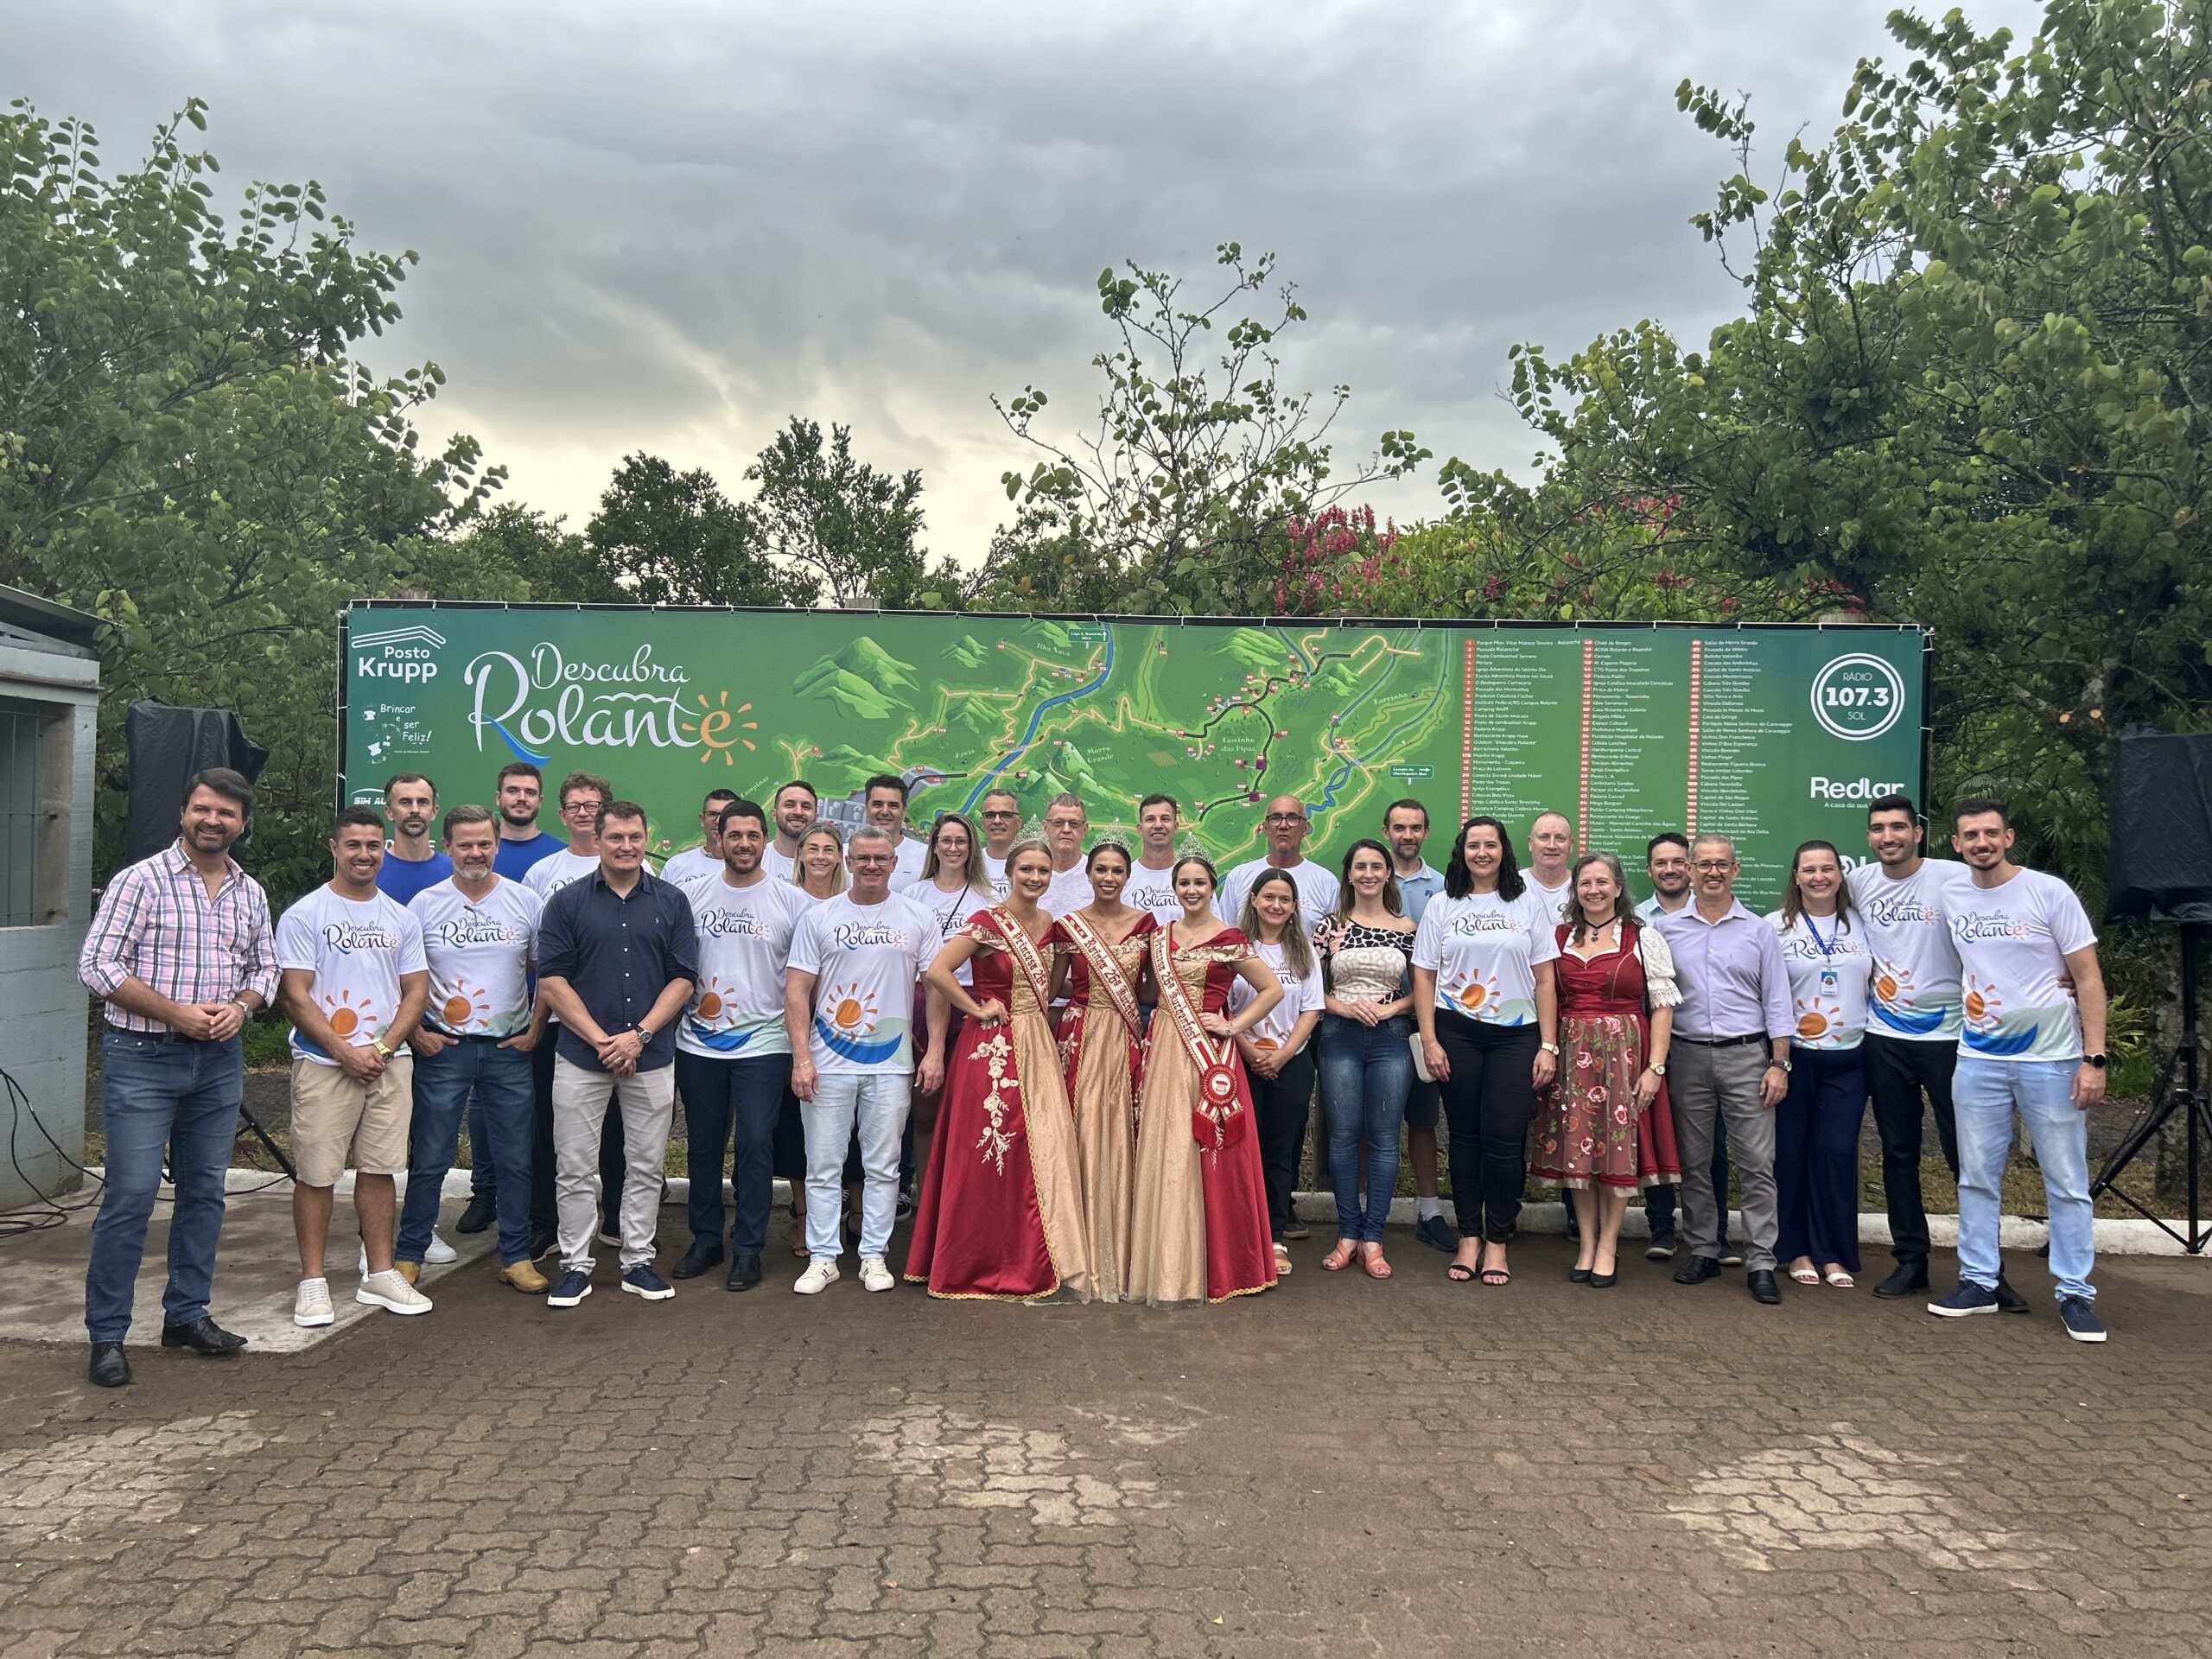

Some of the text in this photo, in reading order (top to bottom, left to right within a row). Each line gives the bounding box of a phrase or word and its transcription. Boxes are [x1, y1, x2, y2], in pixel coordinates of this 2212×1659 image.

[385, 645, 430, 659] Posto
[359, 657, 438, 683] Krupp
[531, 641, 690, 690] Descubra
[1825, 687, 1890, 707] 107.3
[380, 703, 416, 714] Brincar
[464, 651, 741, 766] Rolante
[1847, 711, 1866, 721] SOL
[404, 721, 420, 729] ser
[403, 730, 432, 742] Feliz!
[1086, 746, 1111, 755] Morro
[1087, 753, 1114, 763] Grande
[739, 775, 770, 798] Campinas
[1810, 776, 1904, 799] Redlar
[353, 797, 372, 805] SIM
[1131, 888, 1179, 908] Rolant
[1144, 886, 1174, 895] Descubr
[1884, 895, 1923, 909] Descubra
[717, 907, 754, 919] Descubra
[1468, 909, 1506, 919] Descubra
[1869, 899, 1934, 926] Rolante
[1968, 910, 2009, 923] Descubra
[341, 920, 386, 934] Descubra
[458, 916, 502, 930] Descubra
[701, 910, 764, 938] Rolante
[1452, 918, 1516, 936] Rolante
[1954, 914, 2021, 944] Rolante
[322, 924, 397, 955] Rolante
[440, 920, 515, 949] Rolante
[834, 924, 902, 951] Rolante
[1012, 930, 1037, 971] Princesa
[1084, 938, 1108, 970] Rainha
[1153, 934, 1166, 973] Princesa
[1168, 989, 1201, 1041] Kuchenfest
